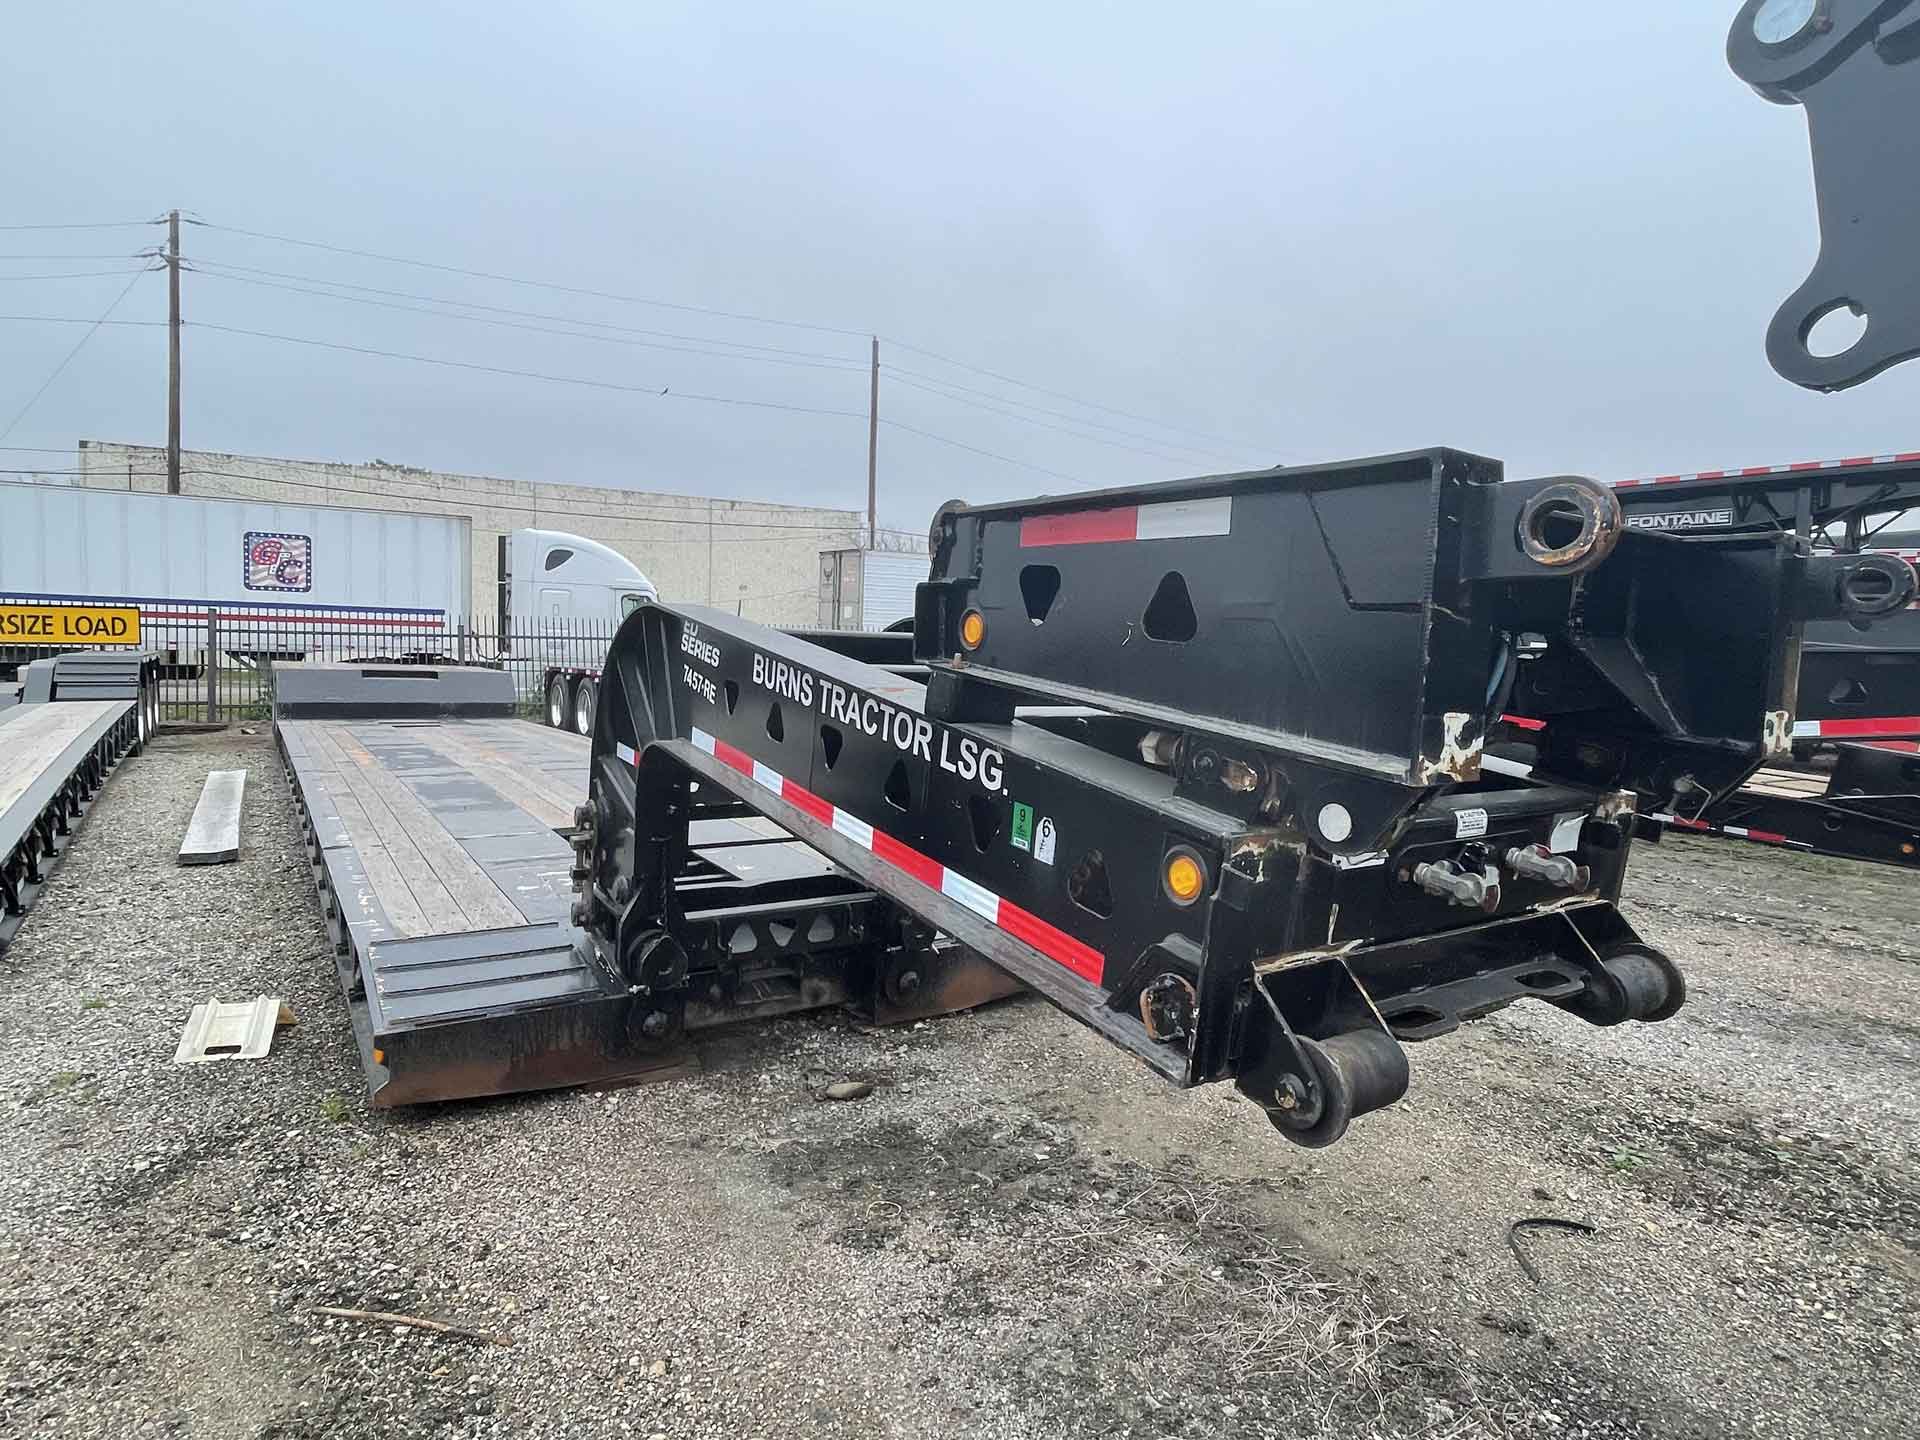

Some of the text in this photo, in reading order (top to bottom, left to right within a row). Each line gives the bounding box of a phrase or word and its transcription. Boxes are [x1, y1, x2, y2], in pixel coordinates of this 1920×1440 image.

[1627, 511, 1730, 528] FONTAINE
[63, 616, 127, 636] LOAD
[681, 633, 720, 667] SERIES
[683, 664, 717, 704] 7457-RE
[752, 652, 1008, 796] BURNS TRACTOR LSG.
[1042, 819, 1052, 838] 6
